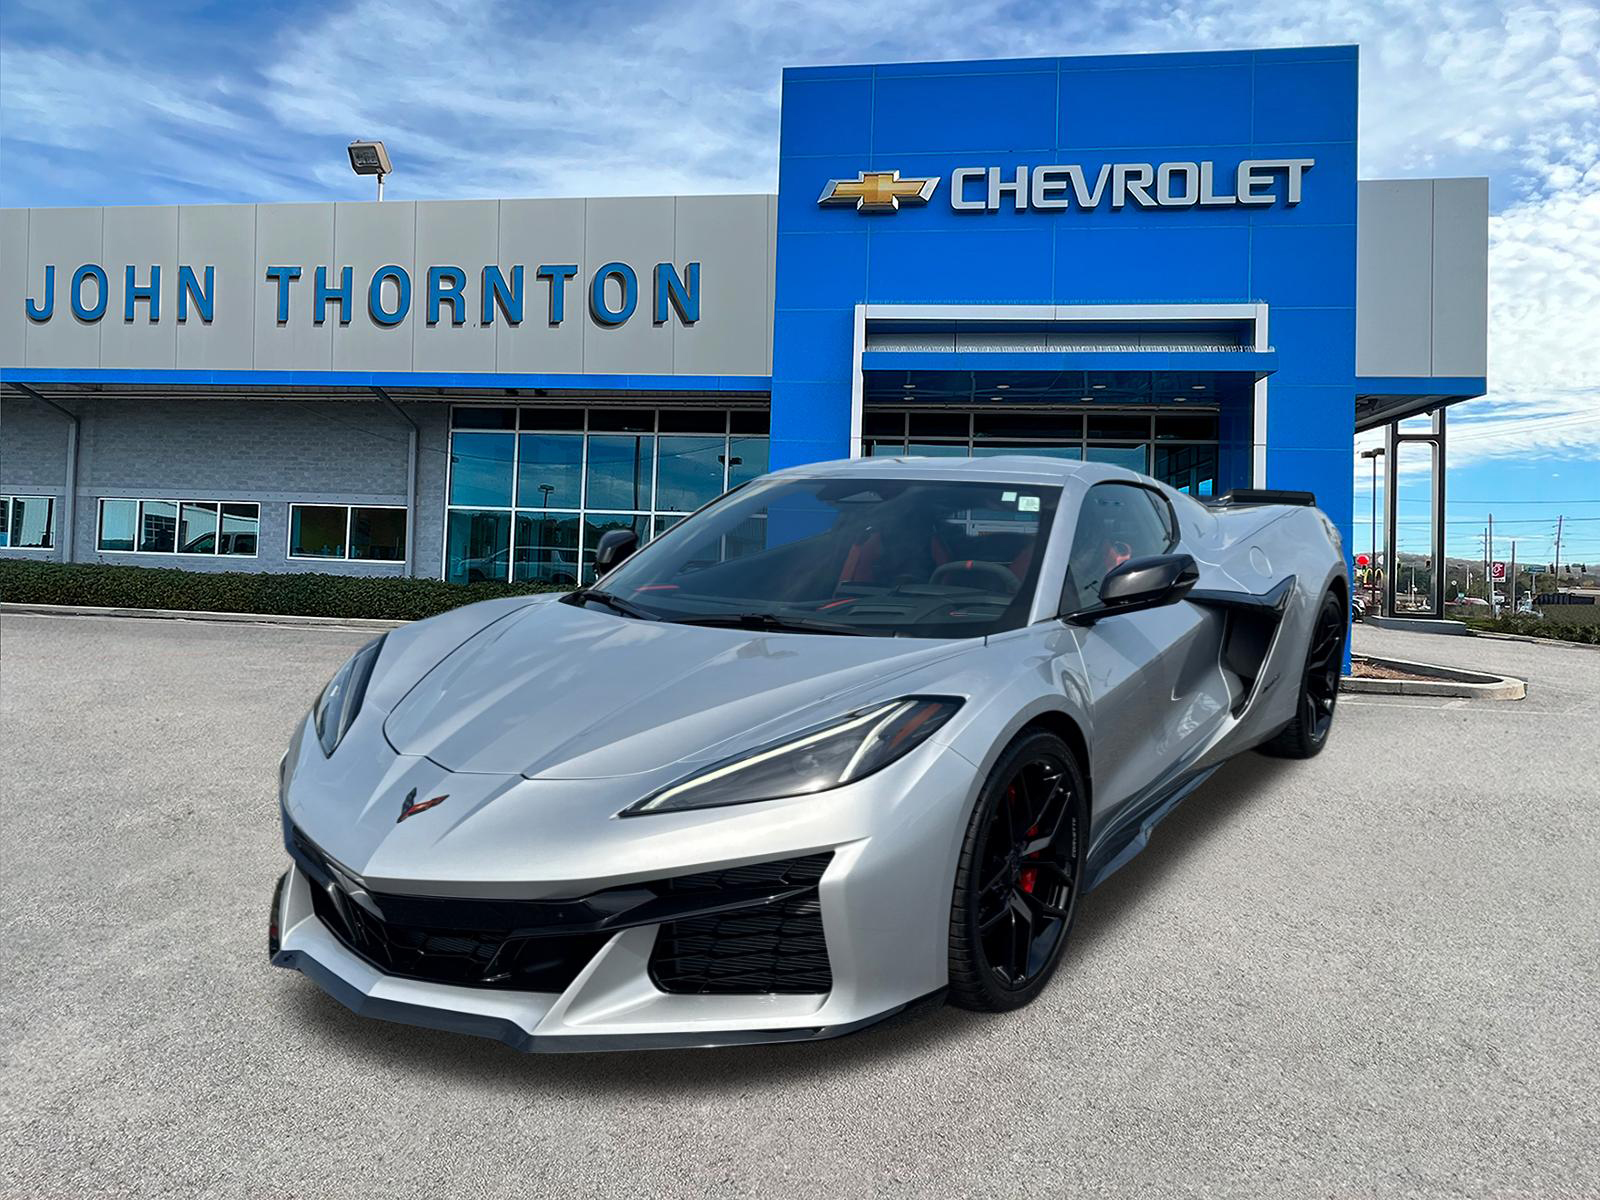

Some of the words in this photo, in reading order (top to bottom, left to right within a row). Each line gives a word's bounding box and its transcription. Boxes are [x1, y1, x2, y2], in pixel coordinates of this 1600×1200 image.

[951, 158, 1315, 211] CHEVROLET
[25, 263, 215, 322] JOHN
[266, 262, 701, 327] THORNTON
